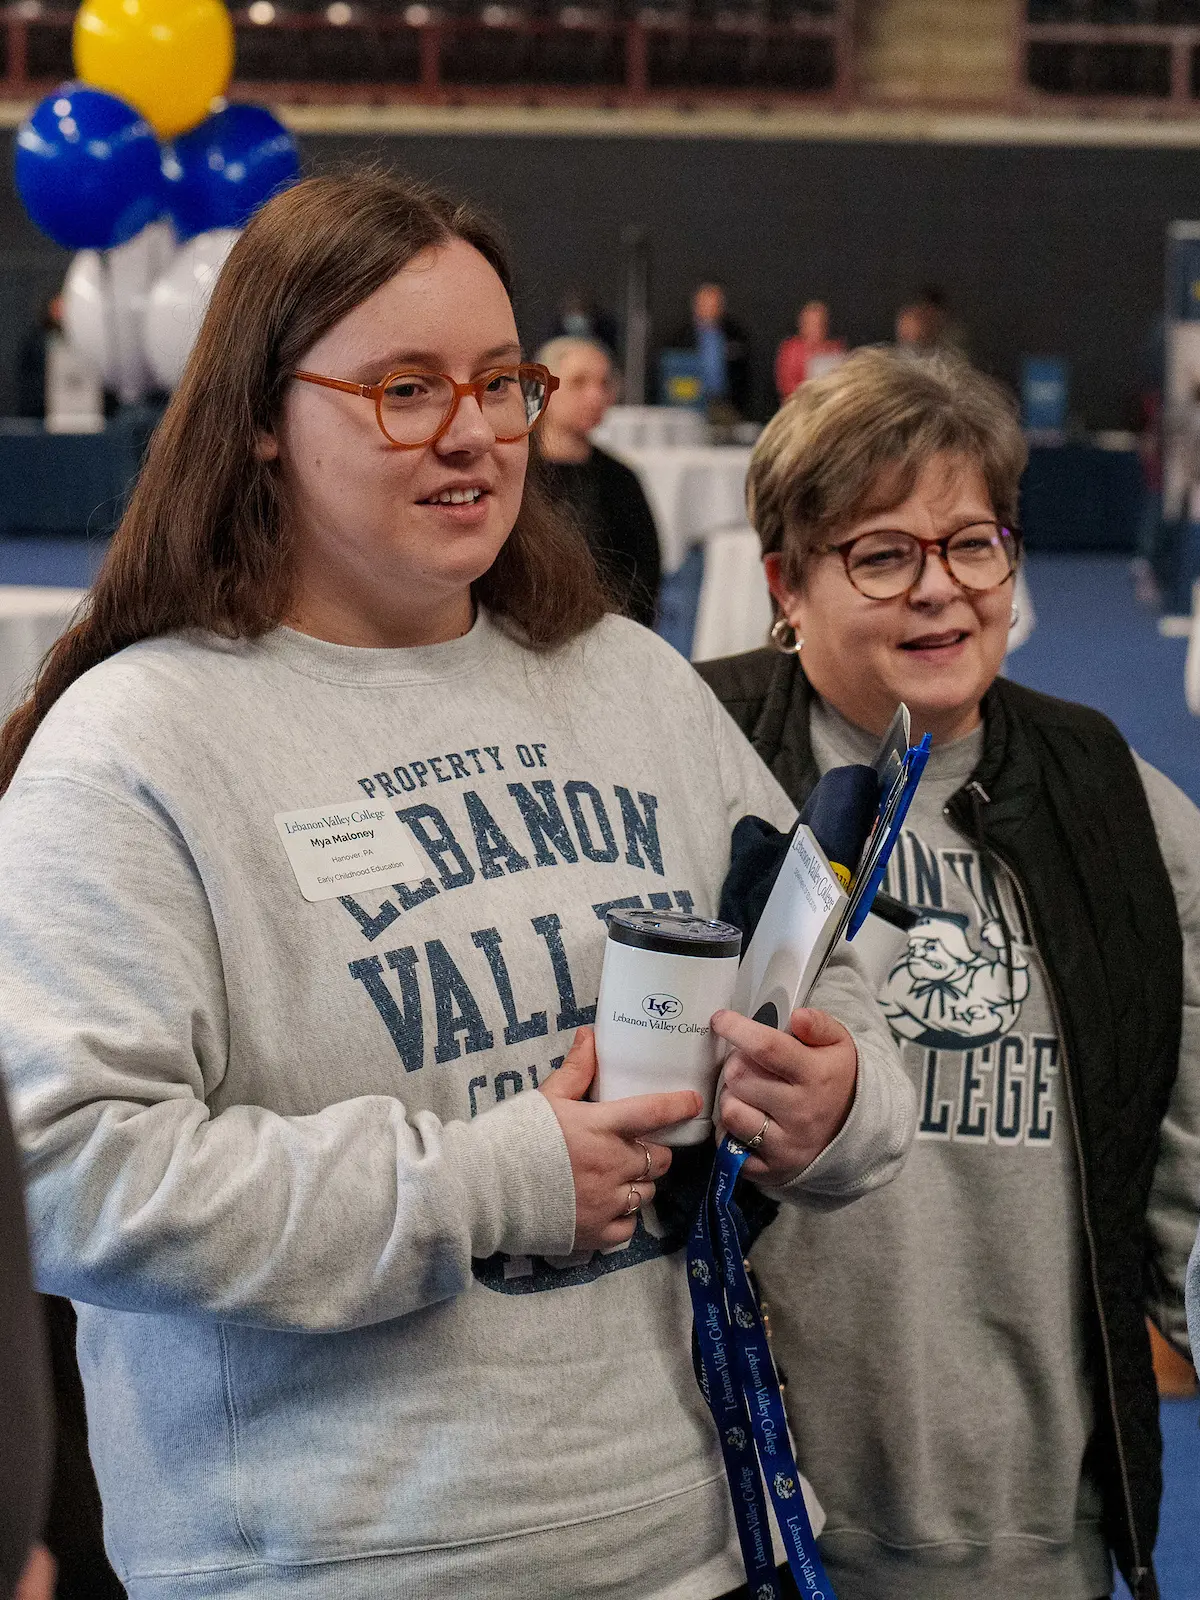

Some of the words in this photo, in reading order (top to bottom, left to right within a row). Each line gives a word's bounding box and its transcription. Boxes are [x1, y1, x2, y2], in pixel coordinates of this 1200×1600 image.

[357, 745, 504, 799] PROPERTY
[515, 743, 547, 768] OF
[284, 821, 324, 834] Lebanon
[322, 815, 350, 829] Valley
[350, 809, 385, 823] College
[310, 836, 331, 848] Mya
[332, 829, 374, 845] Maloney
[335, 779, 665, 942] LBANON
[363, 849, 374, 857] PA
[317, 873, 334, 884] Early
[334, 867, 370, 881] Childhood
[370, 860, 404, 873] Education
[817, 877, 835, 912] College
[347, 890, 695, 1073] VALL
[612, 1011, 648, 1027] Lebanon
[649, 1019, 677, 1033] Valley
[678, 1023, 710, 1036] College
[917, 1032, 1060, 1146] LEGE
[724, 1247, 736, 1286] College
[707, 1303, 723, 1340] College
[745, 1346, 762, 1387] Lebanon
[755, 1387, 770, 1419] Valley
[761, 1419, 778, 1456] College
[740, 1466, 756, 1502] College
[752, 1528, 768, 1569] Lebanon
[786, 1515, 805, 1560] Lebanon
[800, 1558, 817, 1591] Valley
